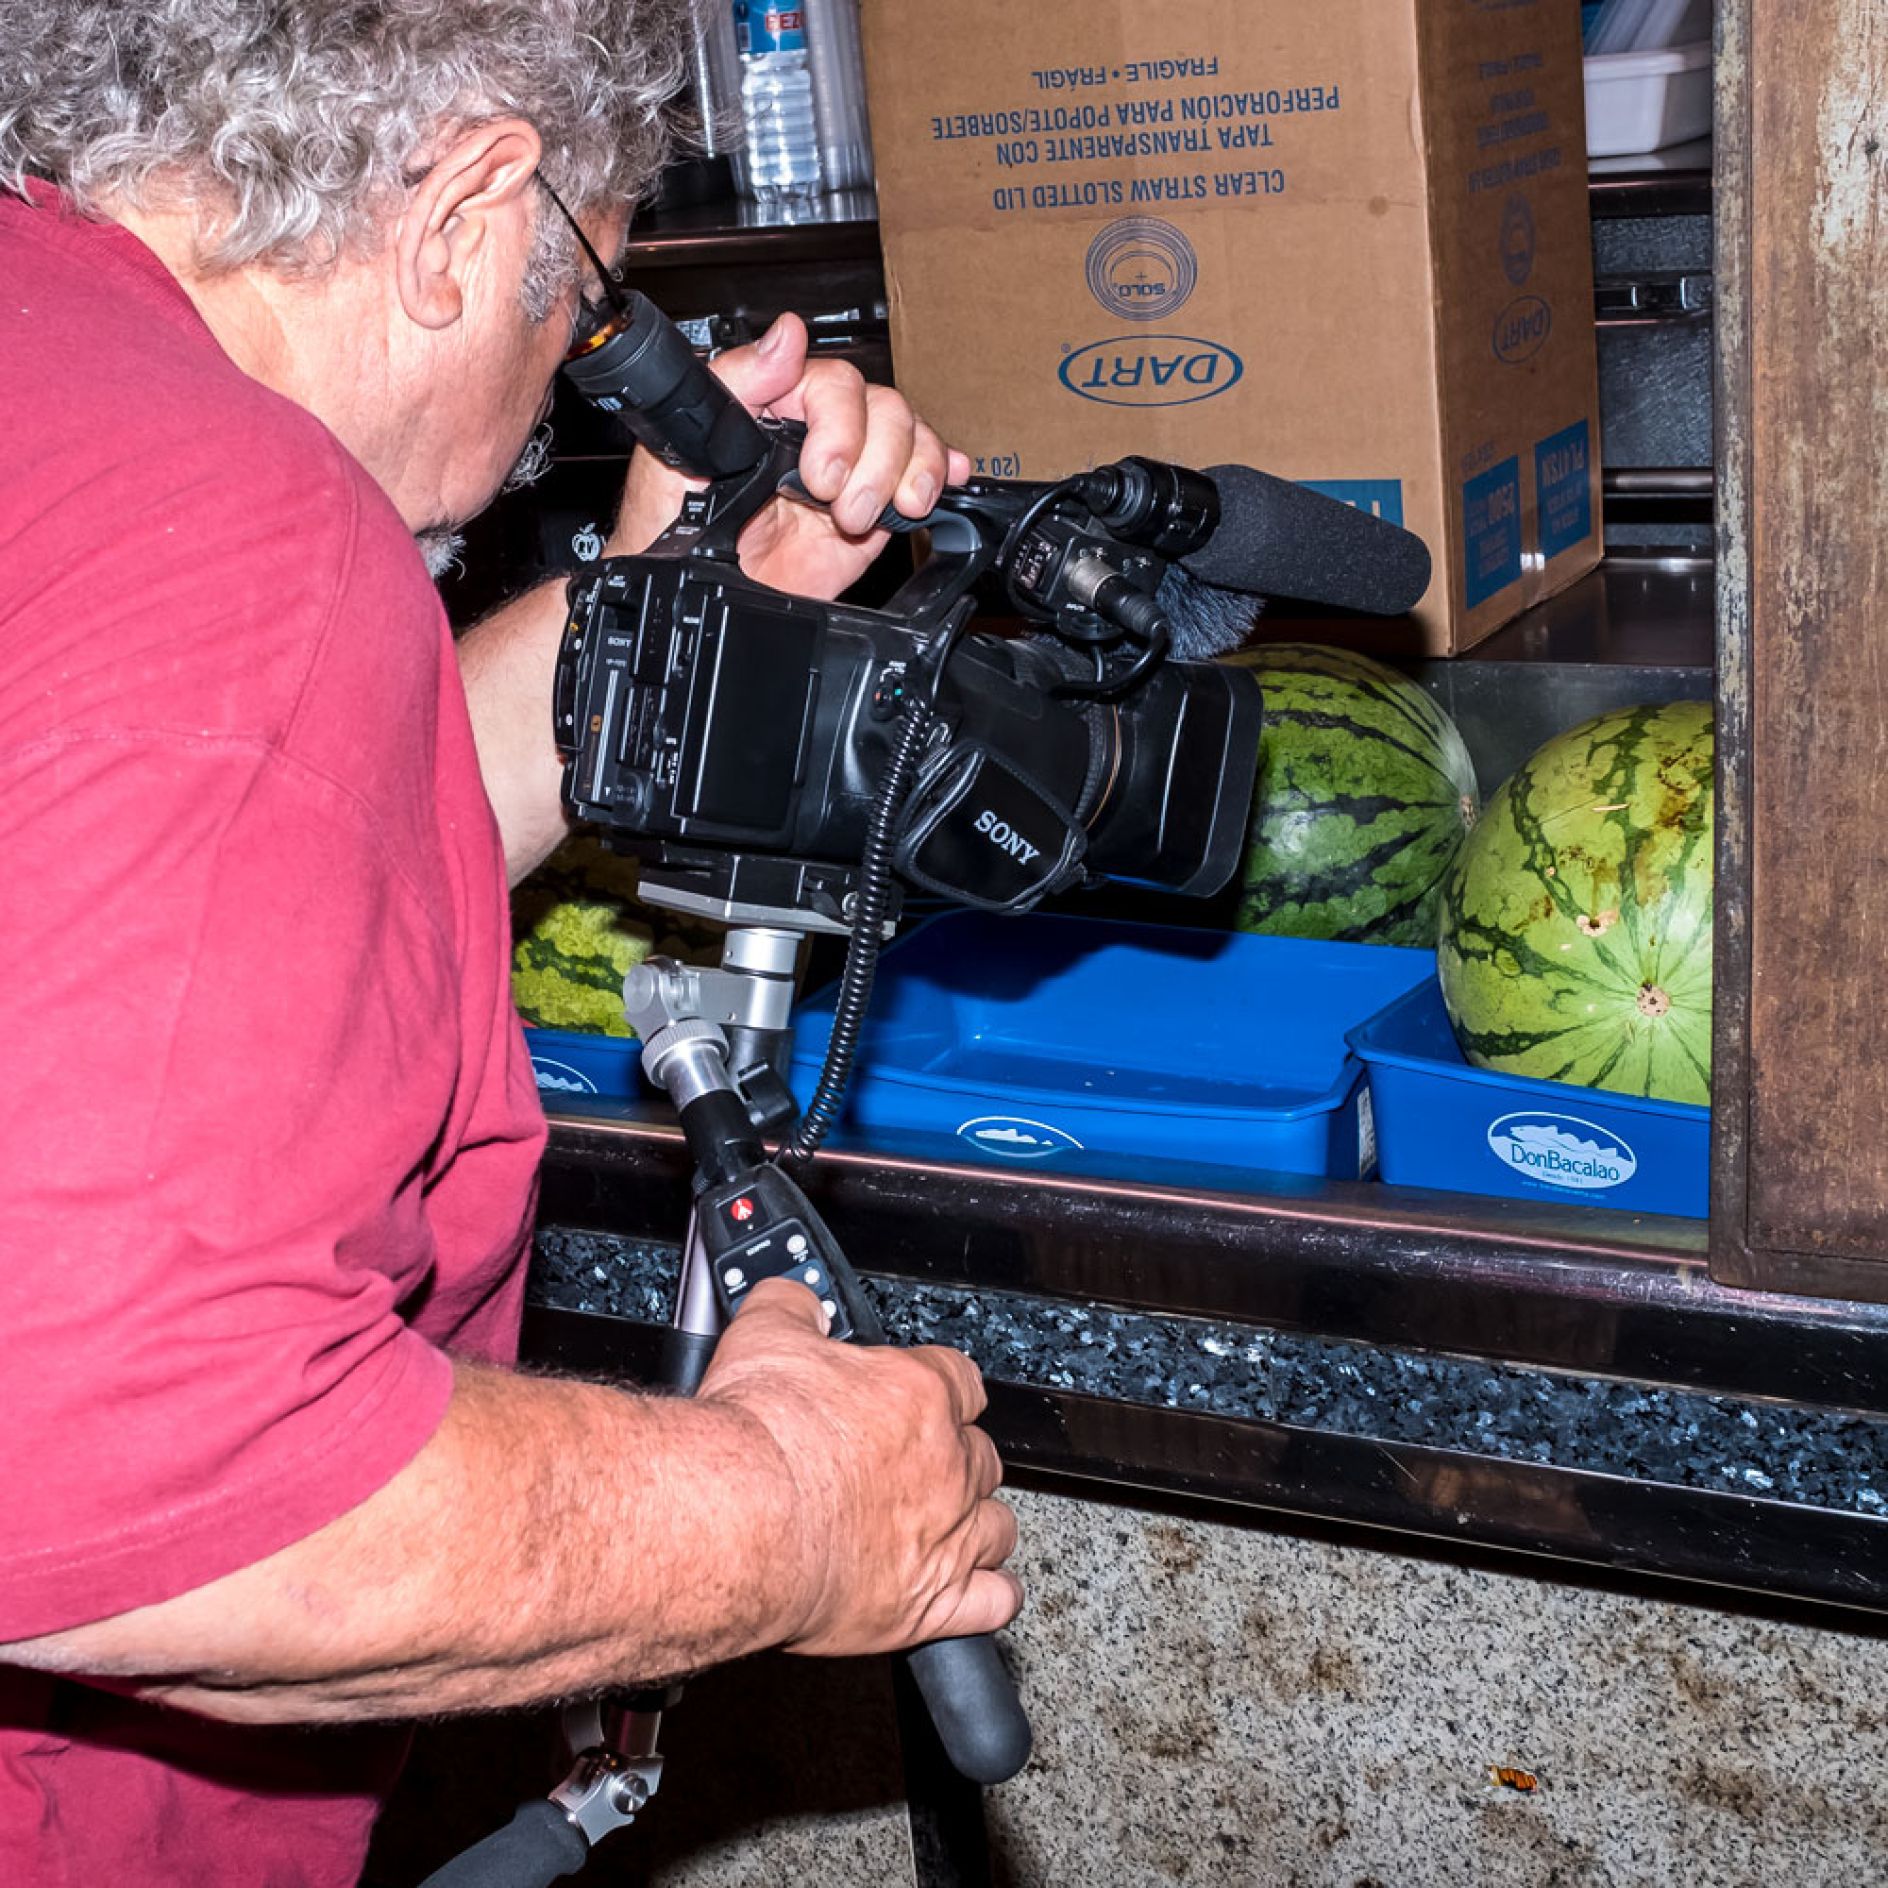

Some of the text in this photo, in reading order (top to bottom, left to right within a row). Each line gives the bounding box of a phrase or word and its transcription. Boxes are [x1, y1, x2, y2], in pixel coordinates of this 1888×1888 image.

[1031, 56, 1219, 92] FRAGILE FRÁGIL
[931, 85, 1339, 140] PERFORACIÓN PARA POPOTE/SORBETE
[996, 123, 1274, 165] TAPA TRANSPARENTE CON
[993, 170, 1285, 210] CLEAR STRAW SLOTTED LID
[1119, 283, 1165, 297] SOLO
[1501, 308, 1545, 352] DART
[1082, 354, 1219, 388] DART
[975, 453, 1021, 478] (20 x
[974, 809, 1040, 866] SONY
[1510, 1143, 1620, 1181] DonBacalao
